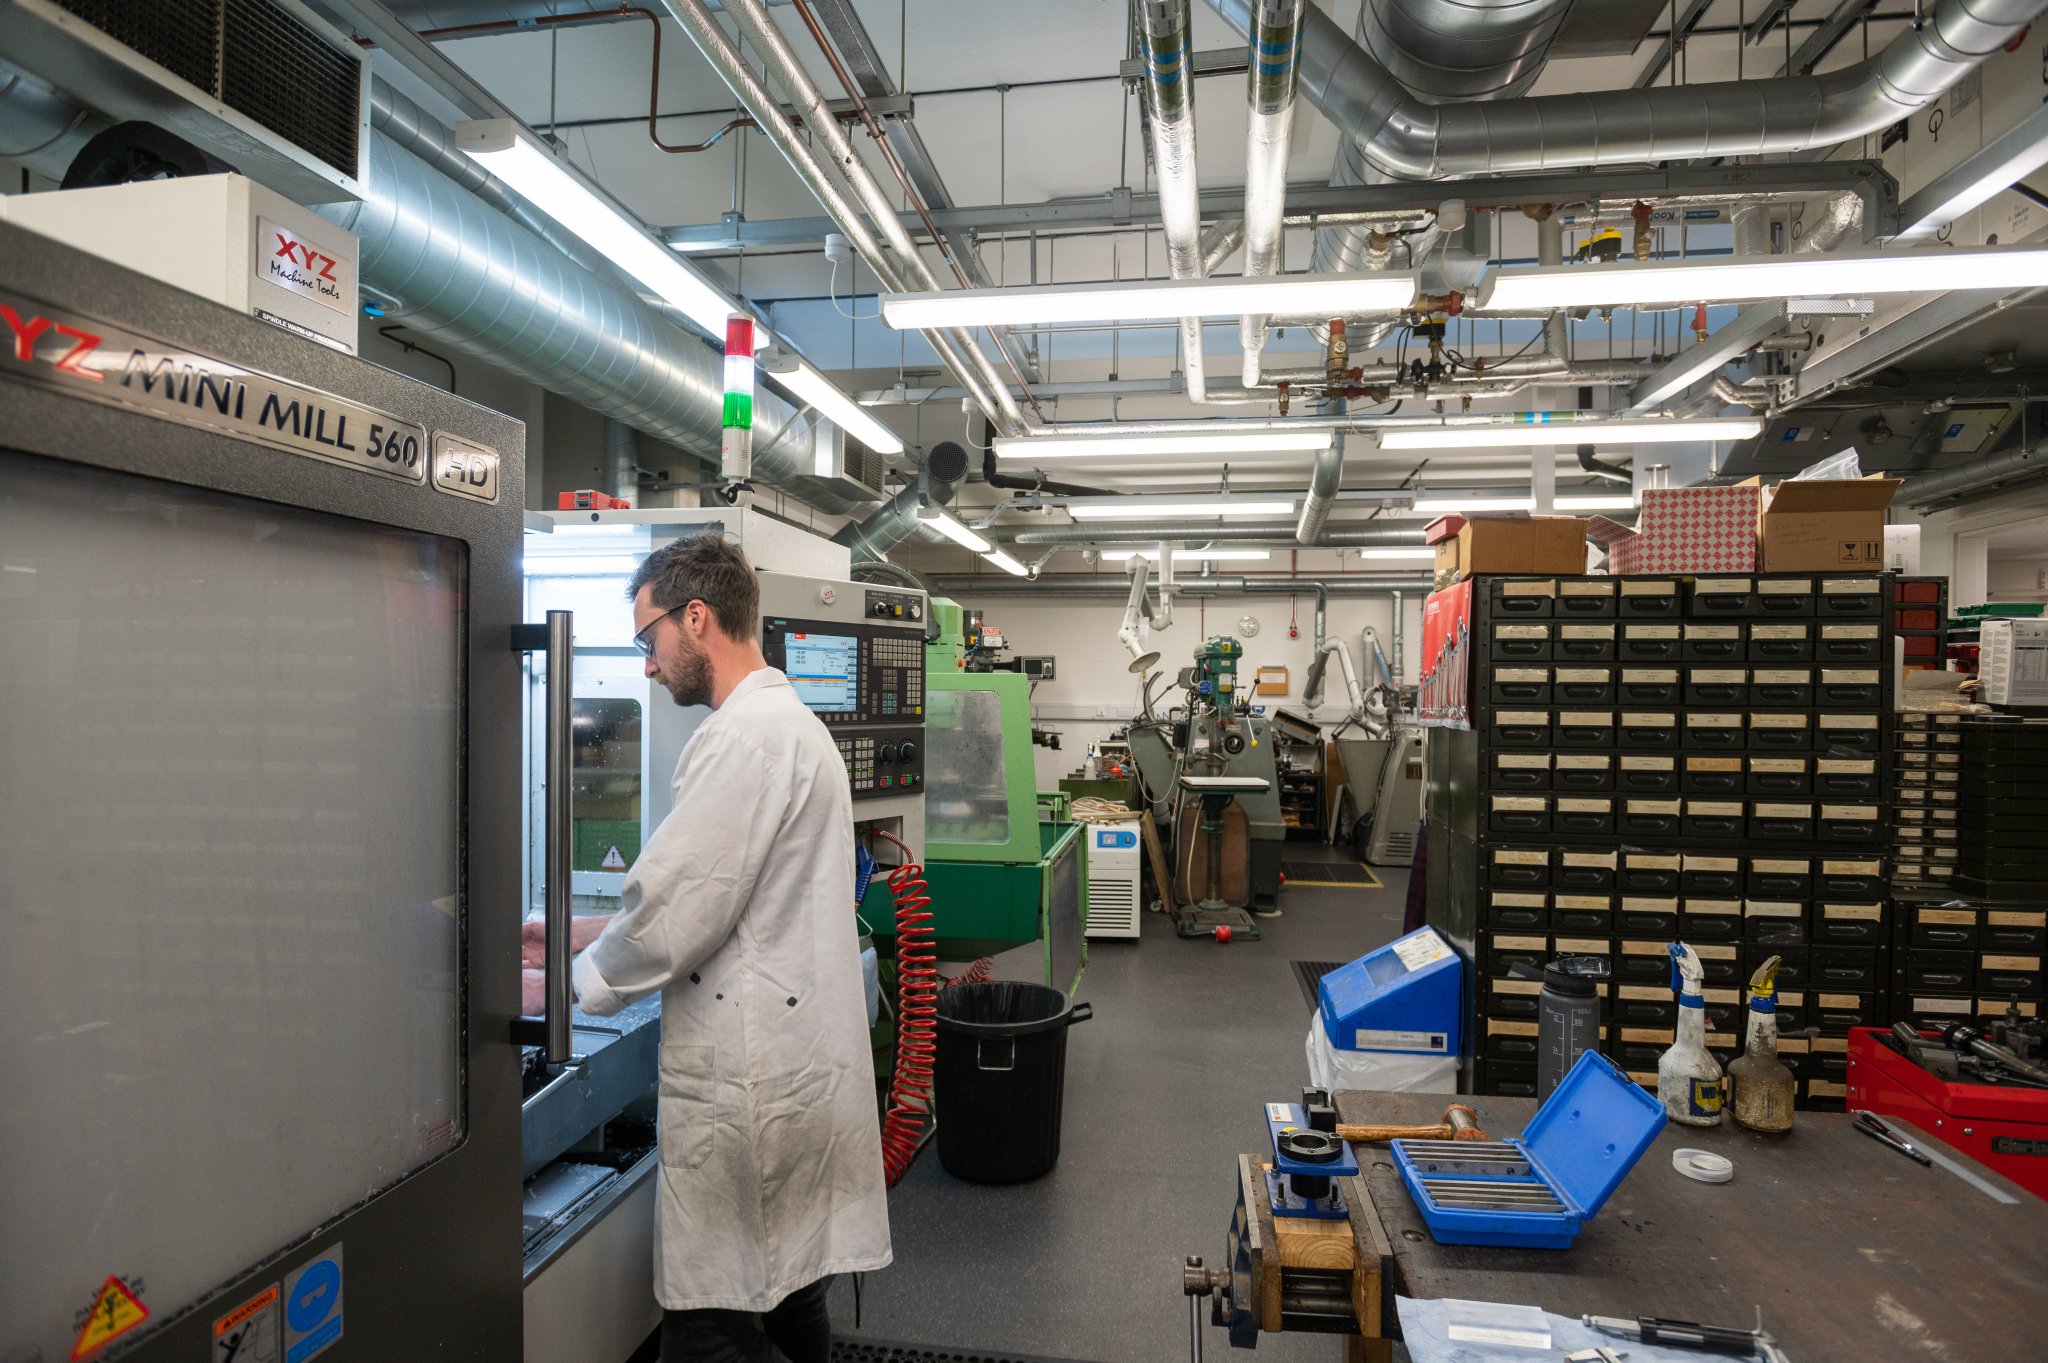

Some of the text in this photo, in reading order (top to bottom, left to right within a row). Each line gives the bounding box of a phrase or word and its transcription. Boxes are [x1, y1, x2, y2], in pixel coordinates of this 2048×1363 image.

[275, 231, 337, 283] XYZ
[270, 259, 341, 299] Machine Tools
[262, 312, 287, 328] SPINDLE
[287, 322, 314, 339] WARM-UP
[120, 348, 248, 420] MINI
[258, 391, 356, 452] MILL
[366, 423, 419, 469] 560
[445, 447, 489, 488] HD
[230, 1291, 274, 1322] WARNING
